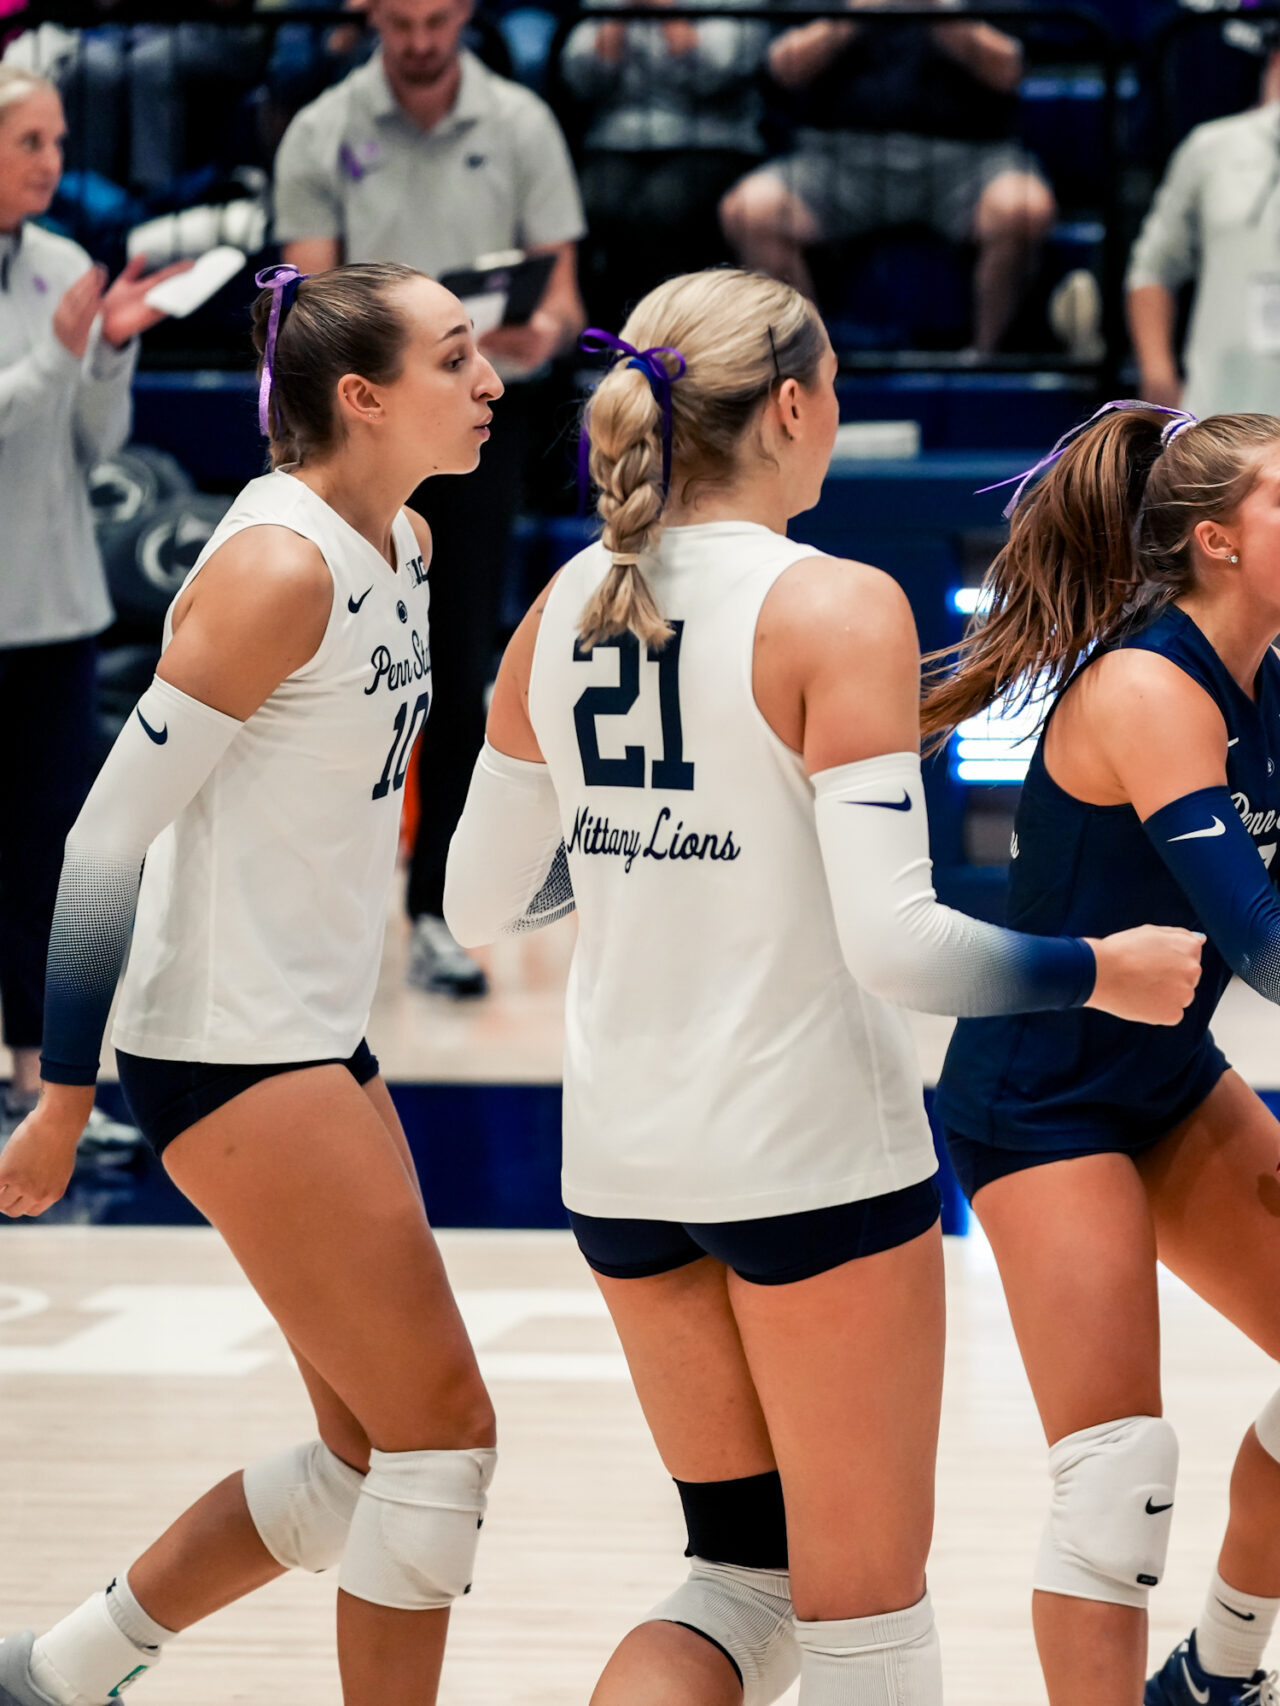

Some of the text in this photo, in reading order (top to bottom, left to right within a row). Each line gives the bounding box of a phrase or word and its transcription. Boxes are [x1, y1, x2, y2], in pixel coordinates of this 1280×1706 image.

[363, 644, 413, 696] Penn
[572, 619, 695, 791] 21
[371, 691, 430, 801] 10
[567, 805, 741, 874] Nittany Lions
